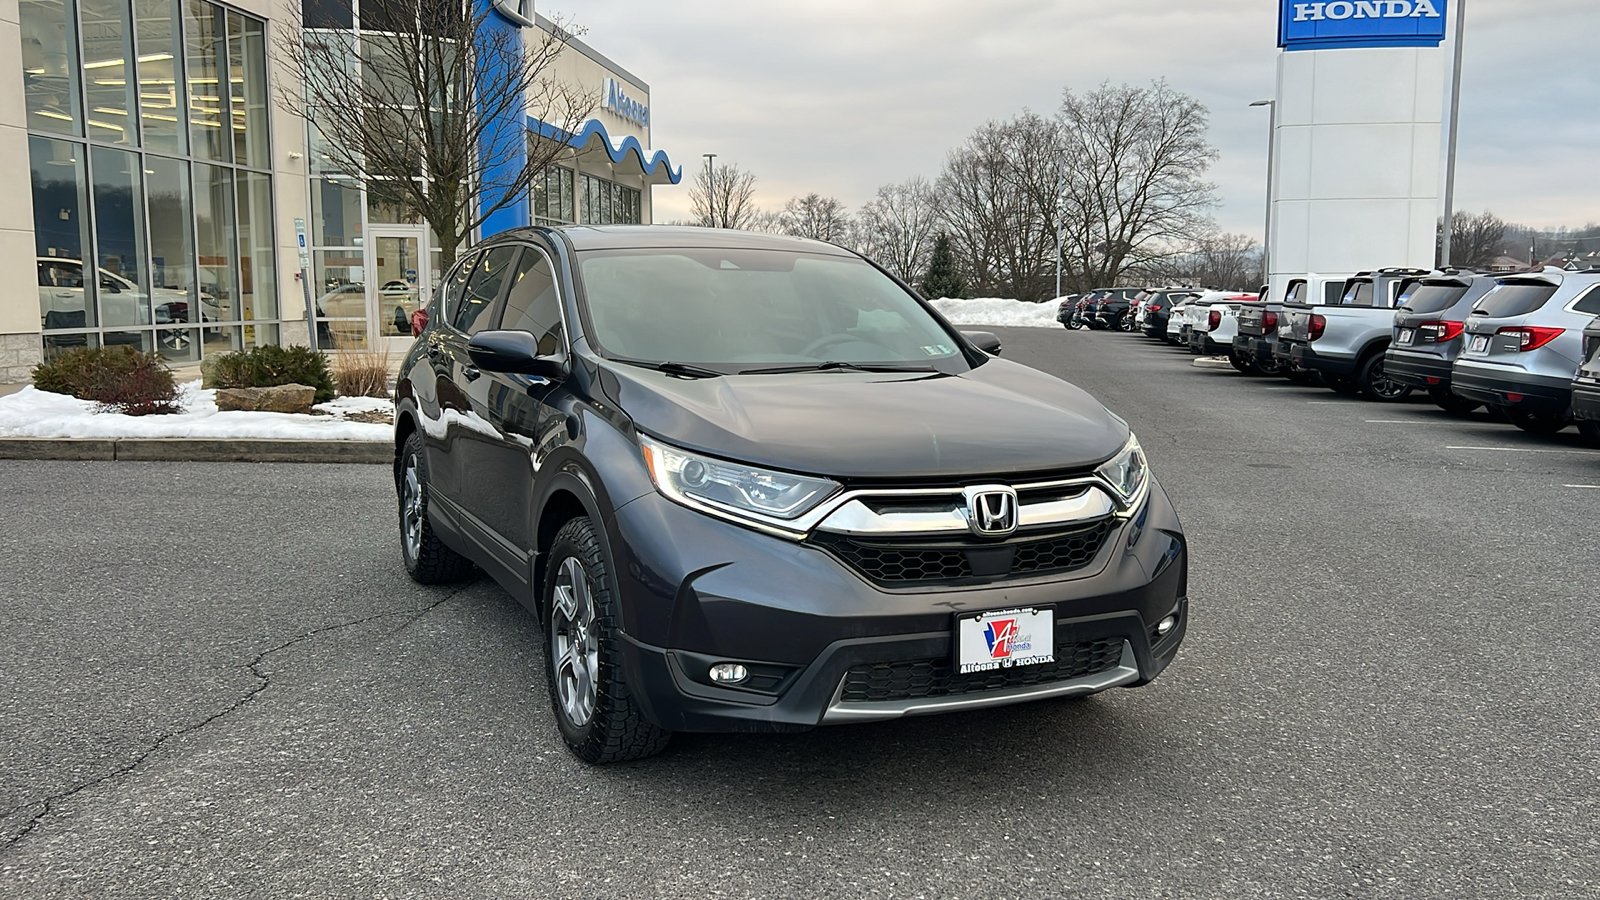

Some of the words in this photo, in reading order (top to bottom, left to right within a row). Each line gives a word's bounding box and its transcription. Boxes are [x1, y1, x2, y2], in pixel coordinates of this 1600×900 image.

[1293, 0, 1440, 21] HONDA
[605, 77, 649, 127] Altoona
[960, 662, 1000, 674] Altoona
[1015, 656, 1055, 666] HONDA
